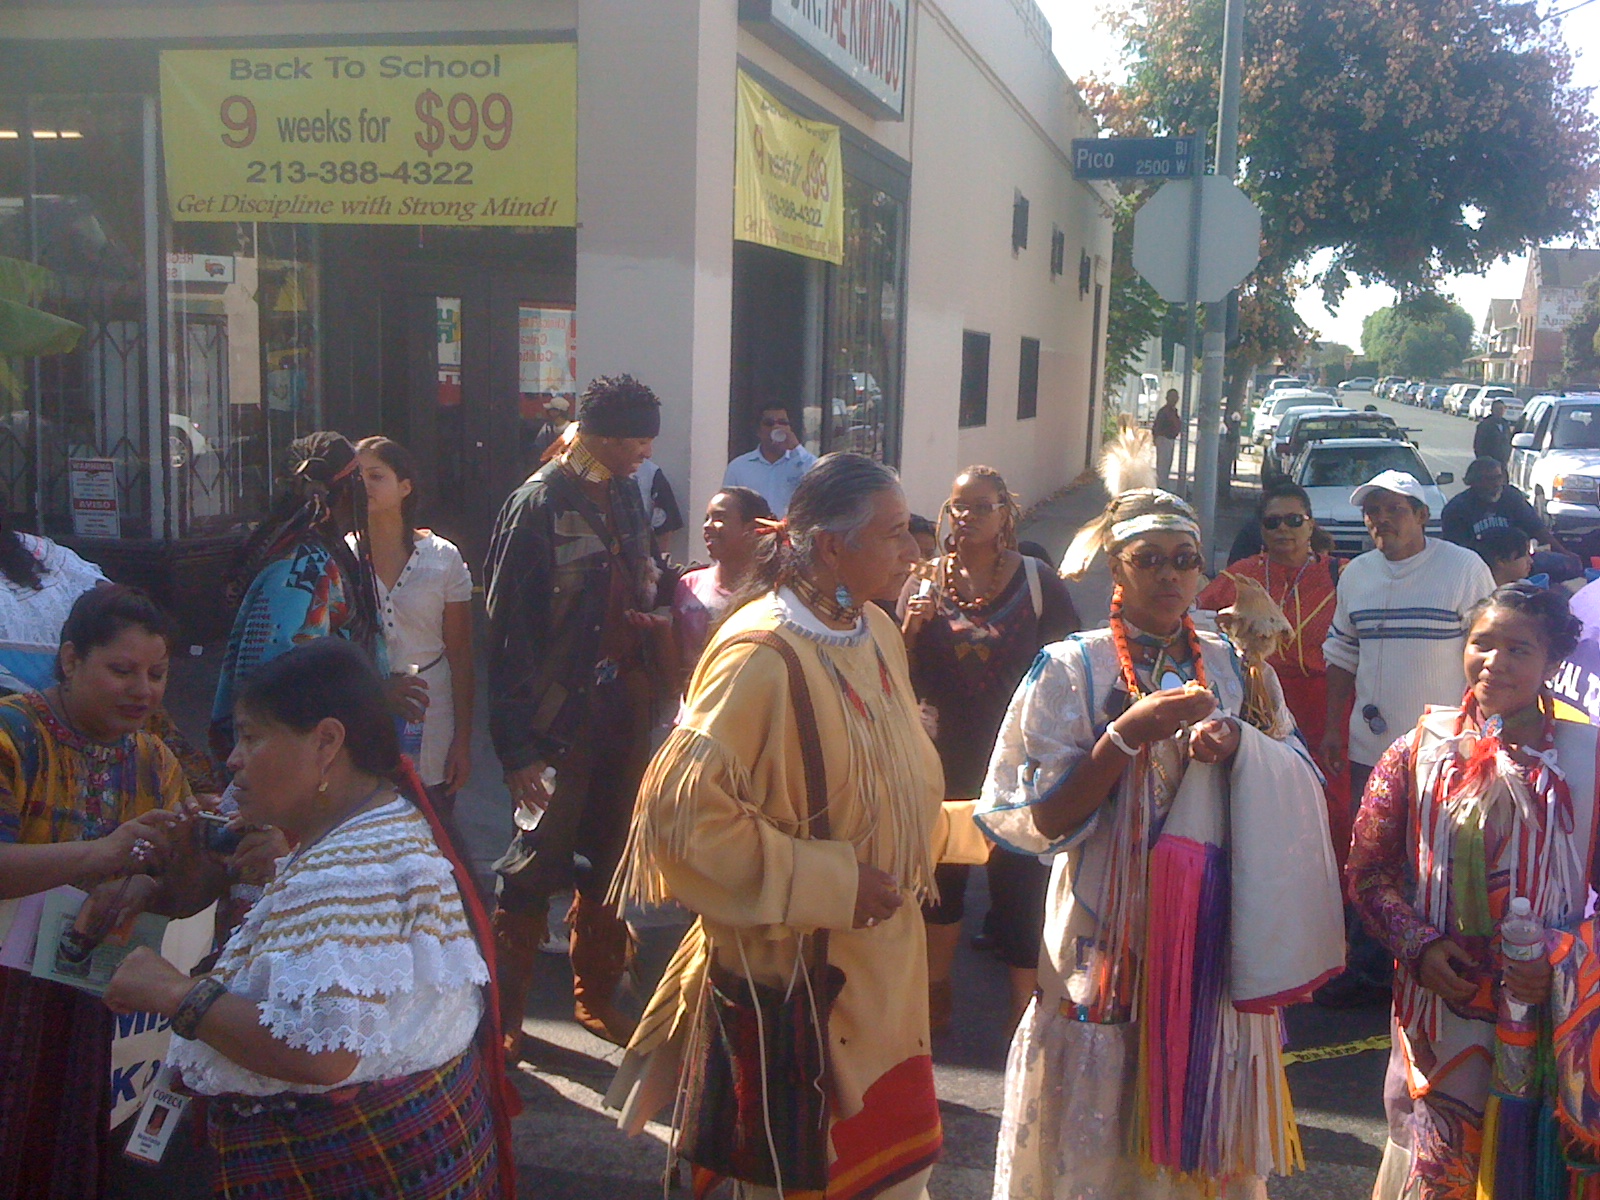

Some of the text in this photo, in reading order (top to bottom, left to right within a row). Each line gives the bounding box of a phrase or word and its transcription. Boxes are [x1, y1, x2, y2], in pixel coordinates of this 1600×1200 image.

[229, 54, 501, 81] Back To School
[219, 88, 514, 158] 9 weeks for $99
[246, 160, 474, 186] 213-388-4322
[1136, 159, 1170, 175] 2500
[1175, 159, 1188, 173] W
[177, 193, 559, 222] Get Discipline with Strong Mind!
